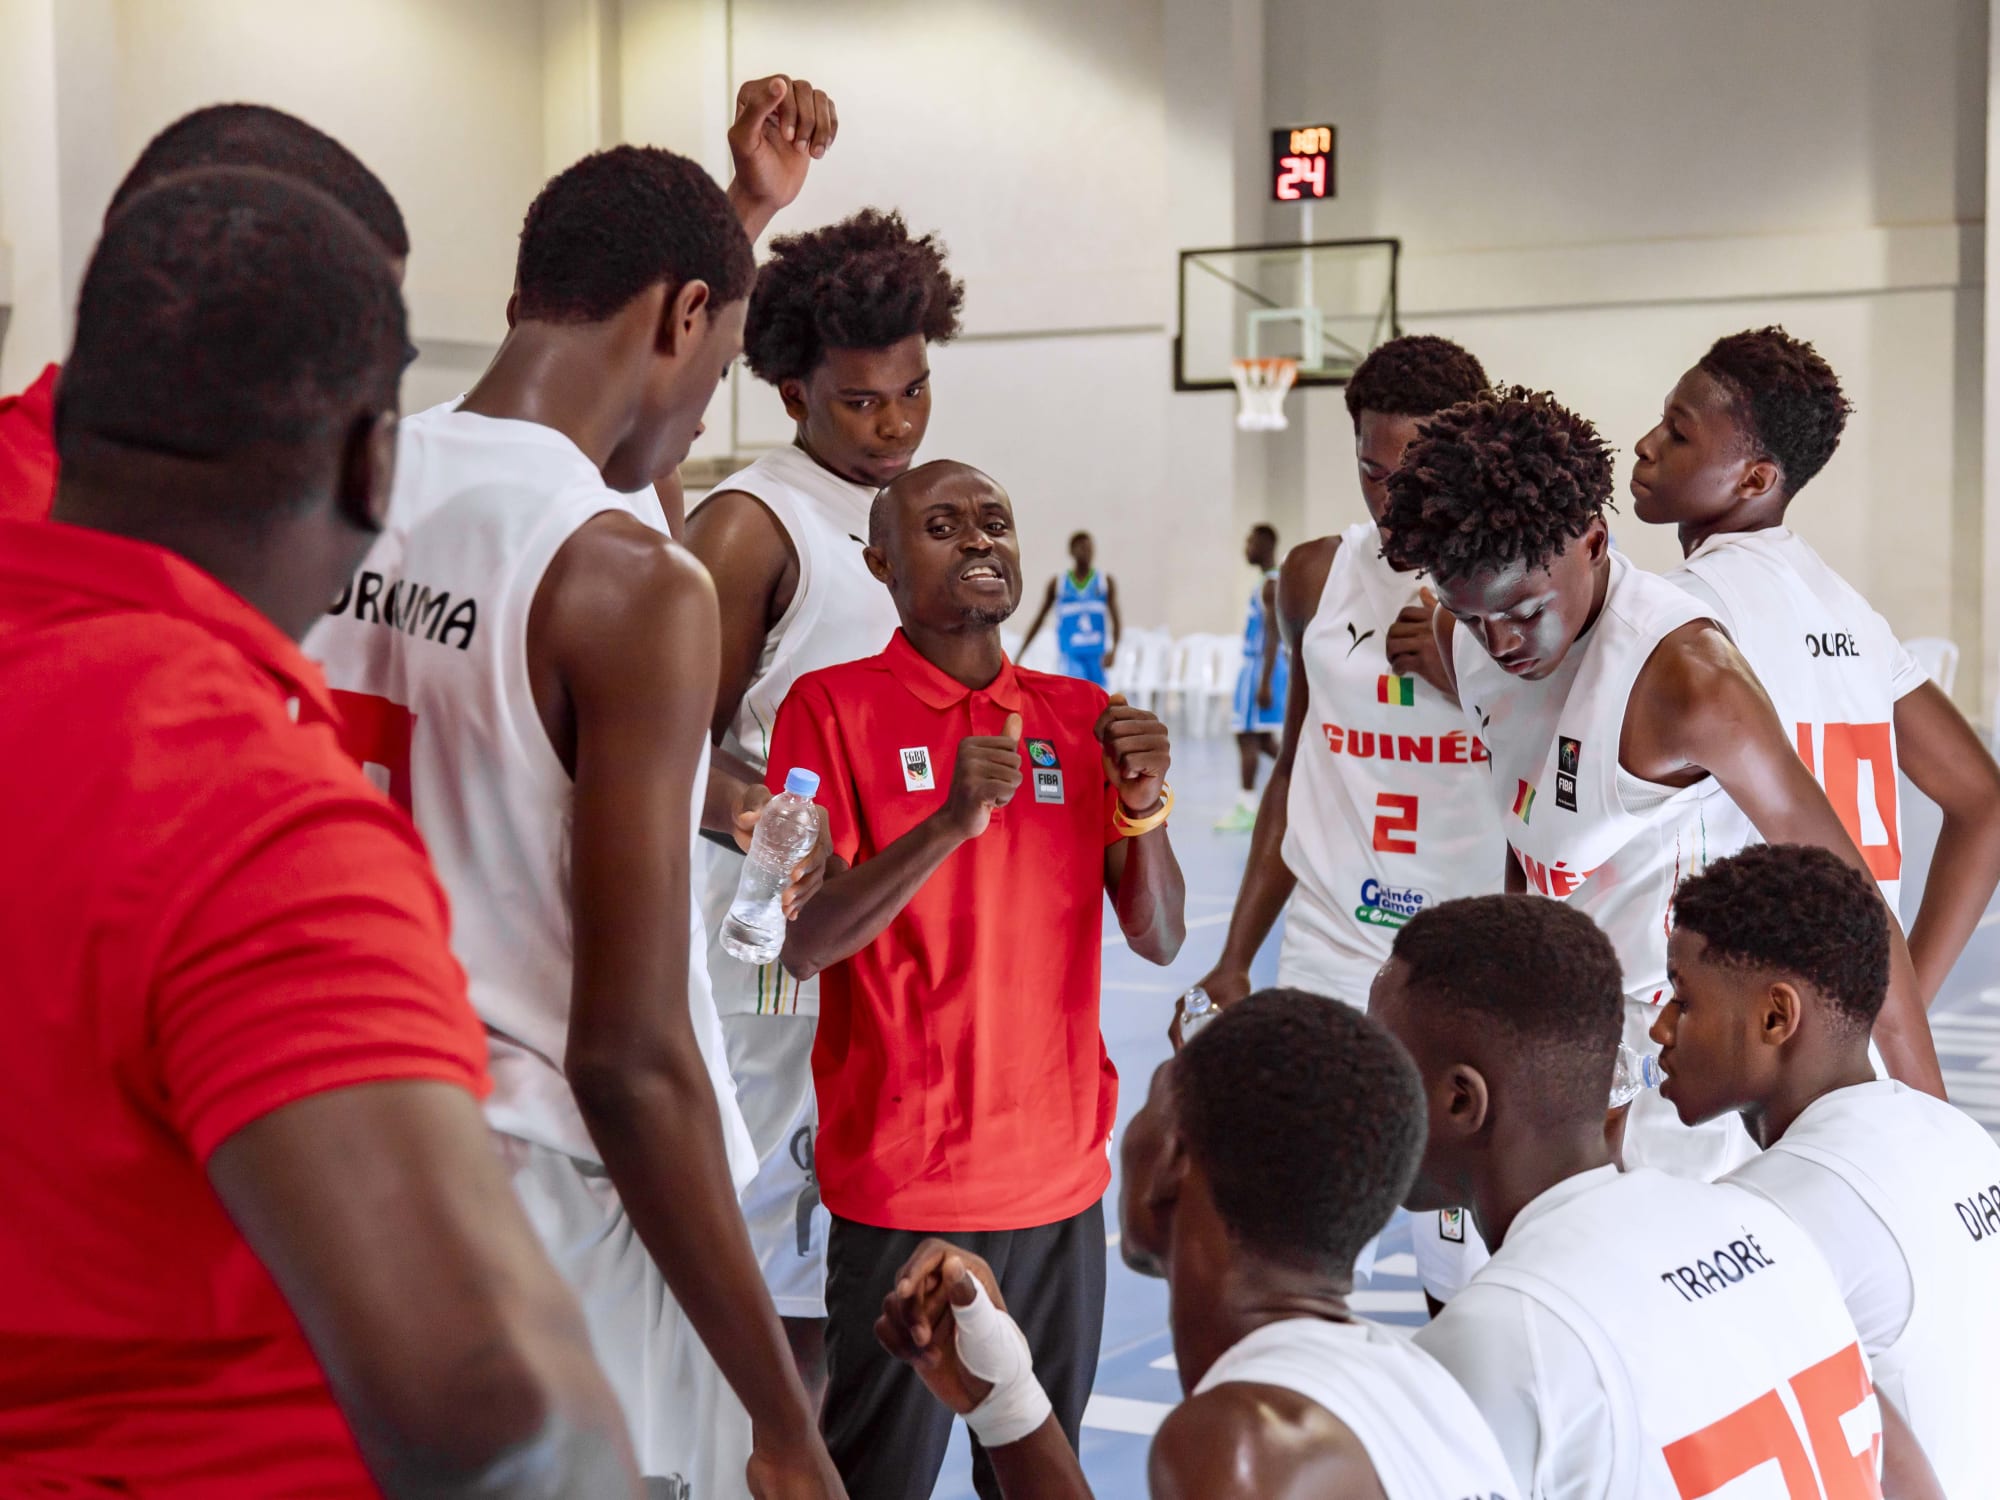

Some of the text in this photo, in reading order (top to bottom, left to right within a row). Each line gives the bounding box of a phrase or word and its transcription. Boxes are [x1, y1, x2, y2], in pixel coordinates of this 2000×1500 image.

[1277, 156, 1326, 200] 24
[1038, 773, 1058, 785] FIBA
[1558, 777, 1573, 794] FIBA
[1373, 792, 1418, 855] 2
[1660, 1224, 1776, 1303] TRAORÉ
